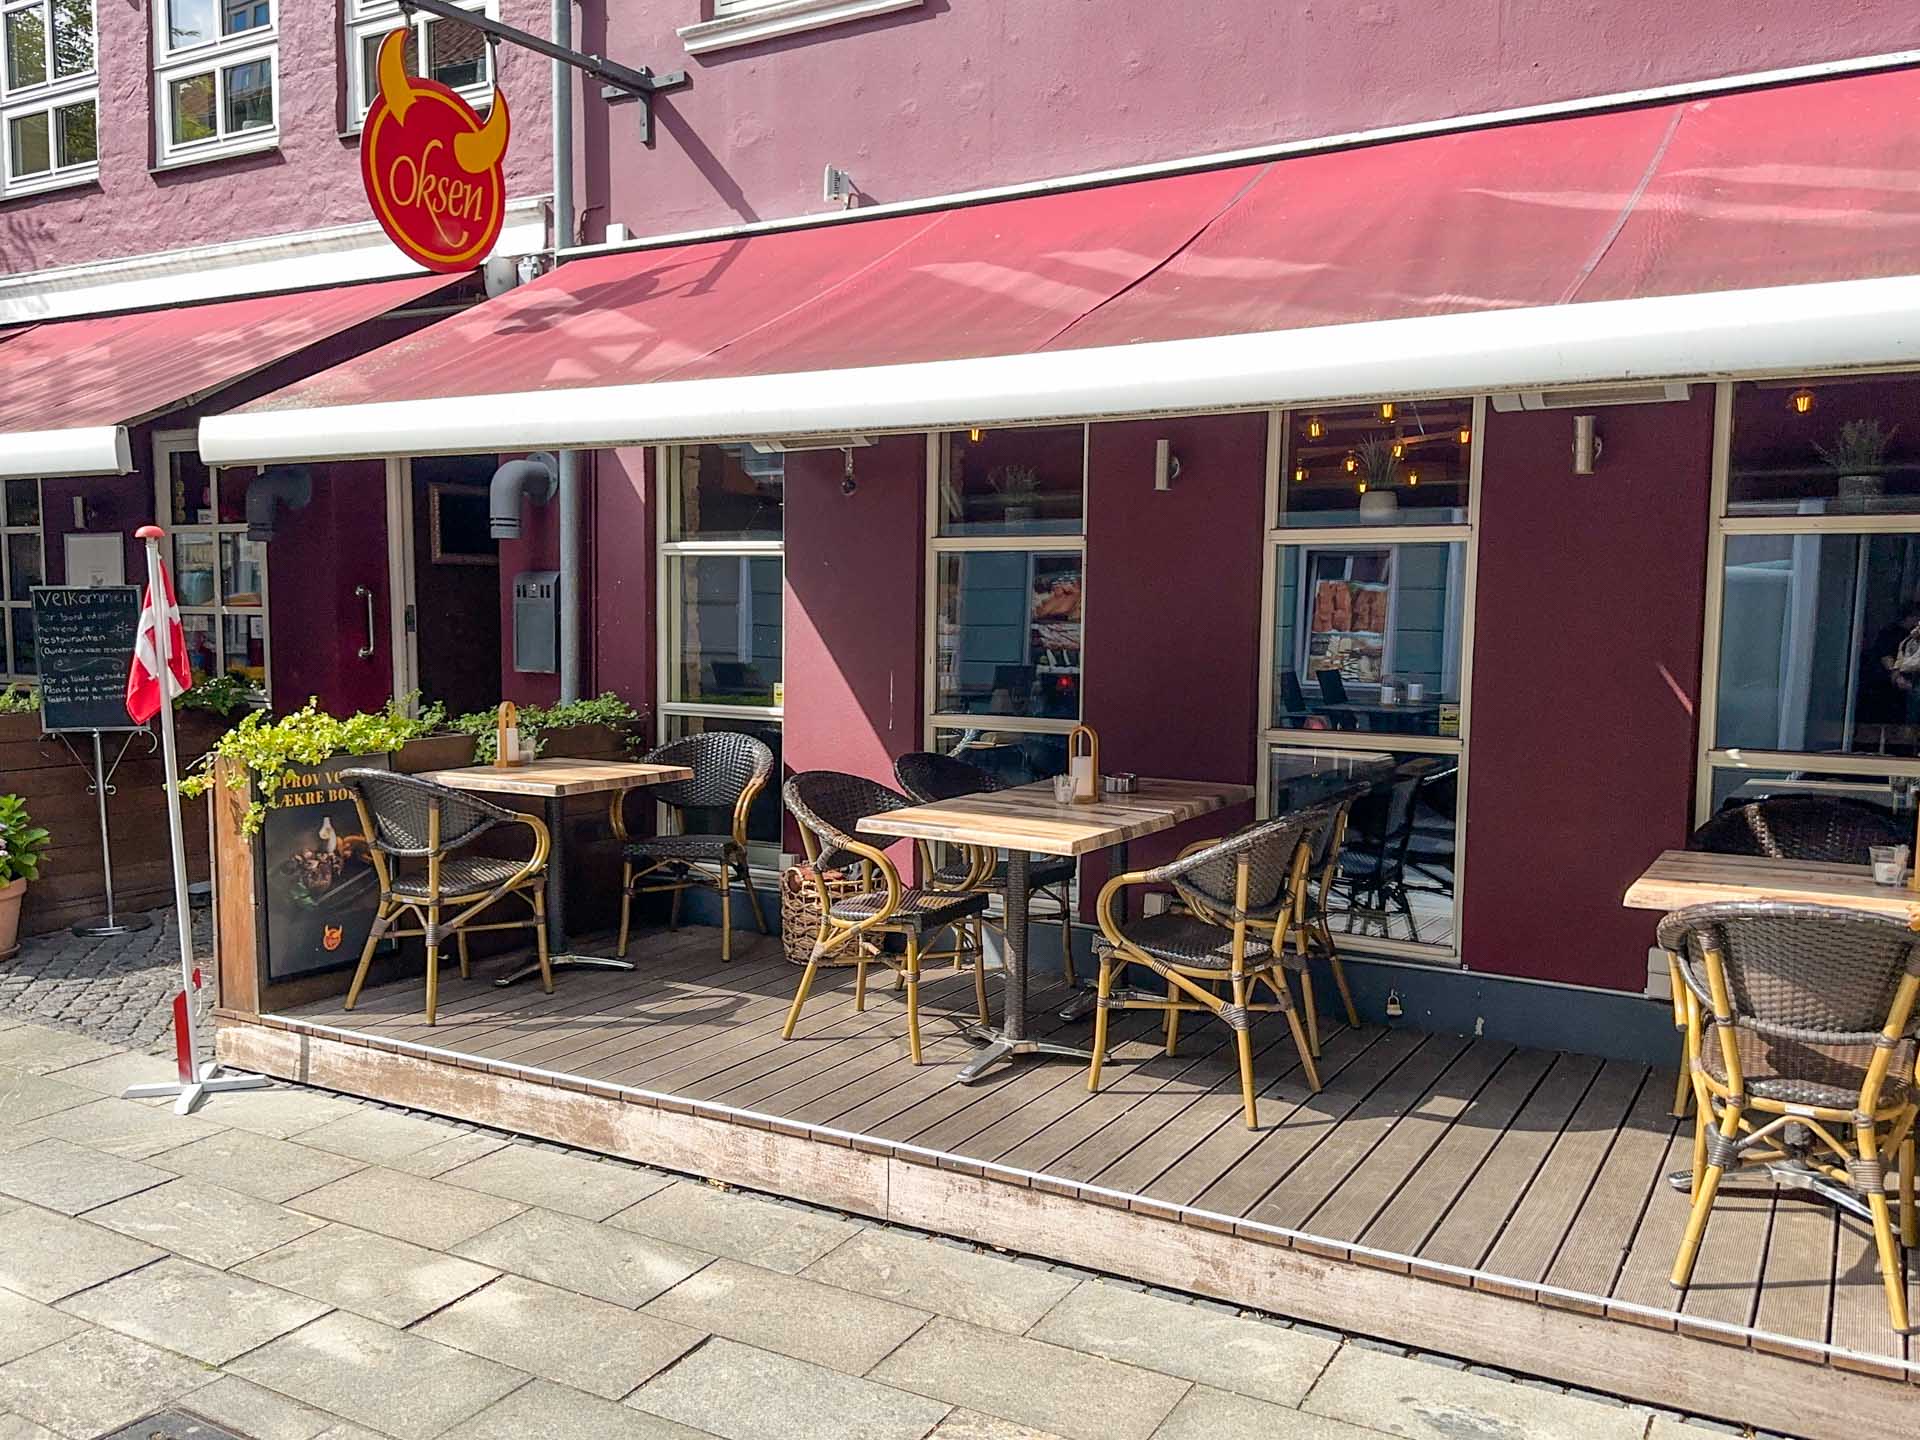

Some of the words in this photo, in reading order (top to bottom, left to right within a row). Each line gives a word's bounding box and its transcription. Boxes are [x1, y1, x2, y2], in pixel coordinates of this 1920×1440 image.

[389, 139, 484, 248] Oksen
[39, 590, 134, 607] Velkommen
[280, 790, 325, 807] ÆKRE
